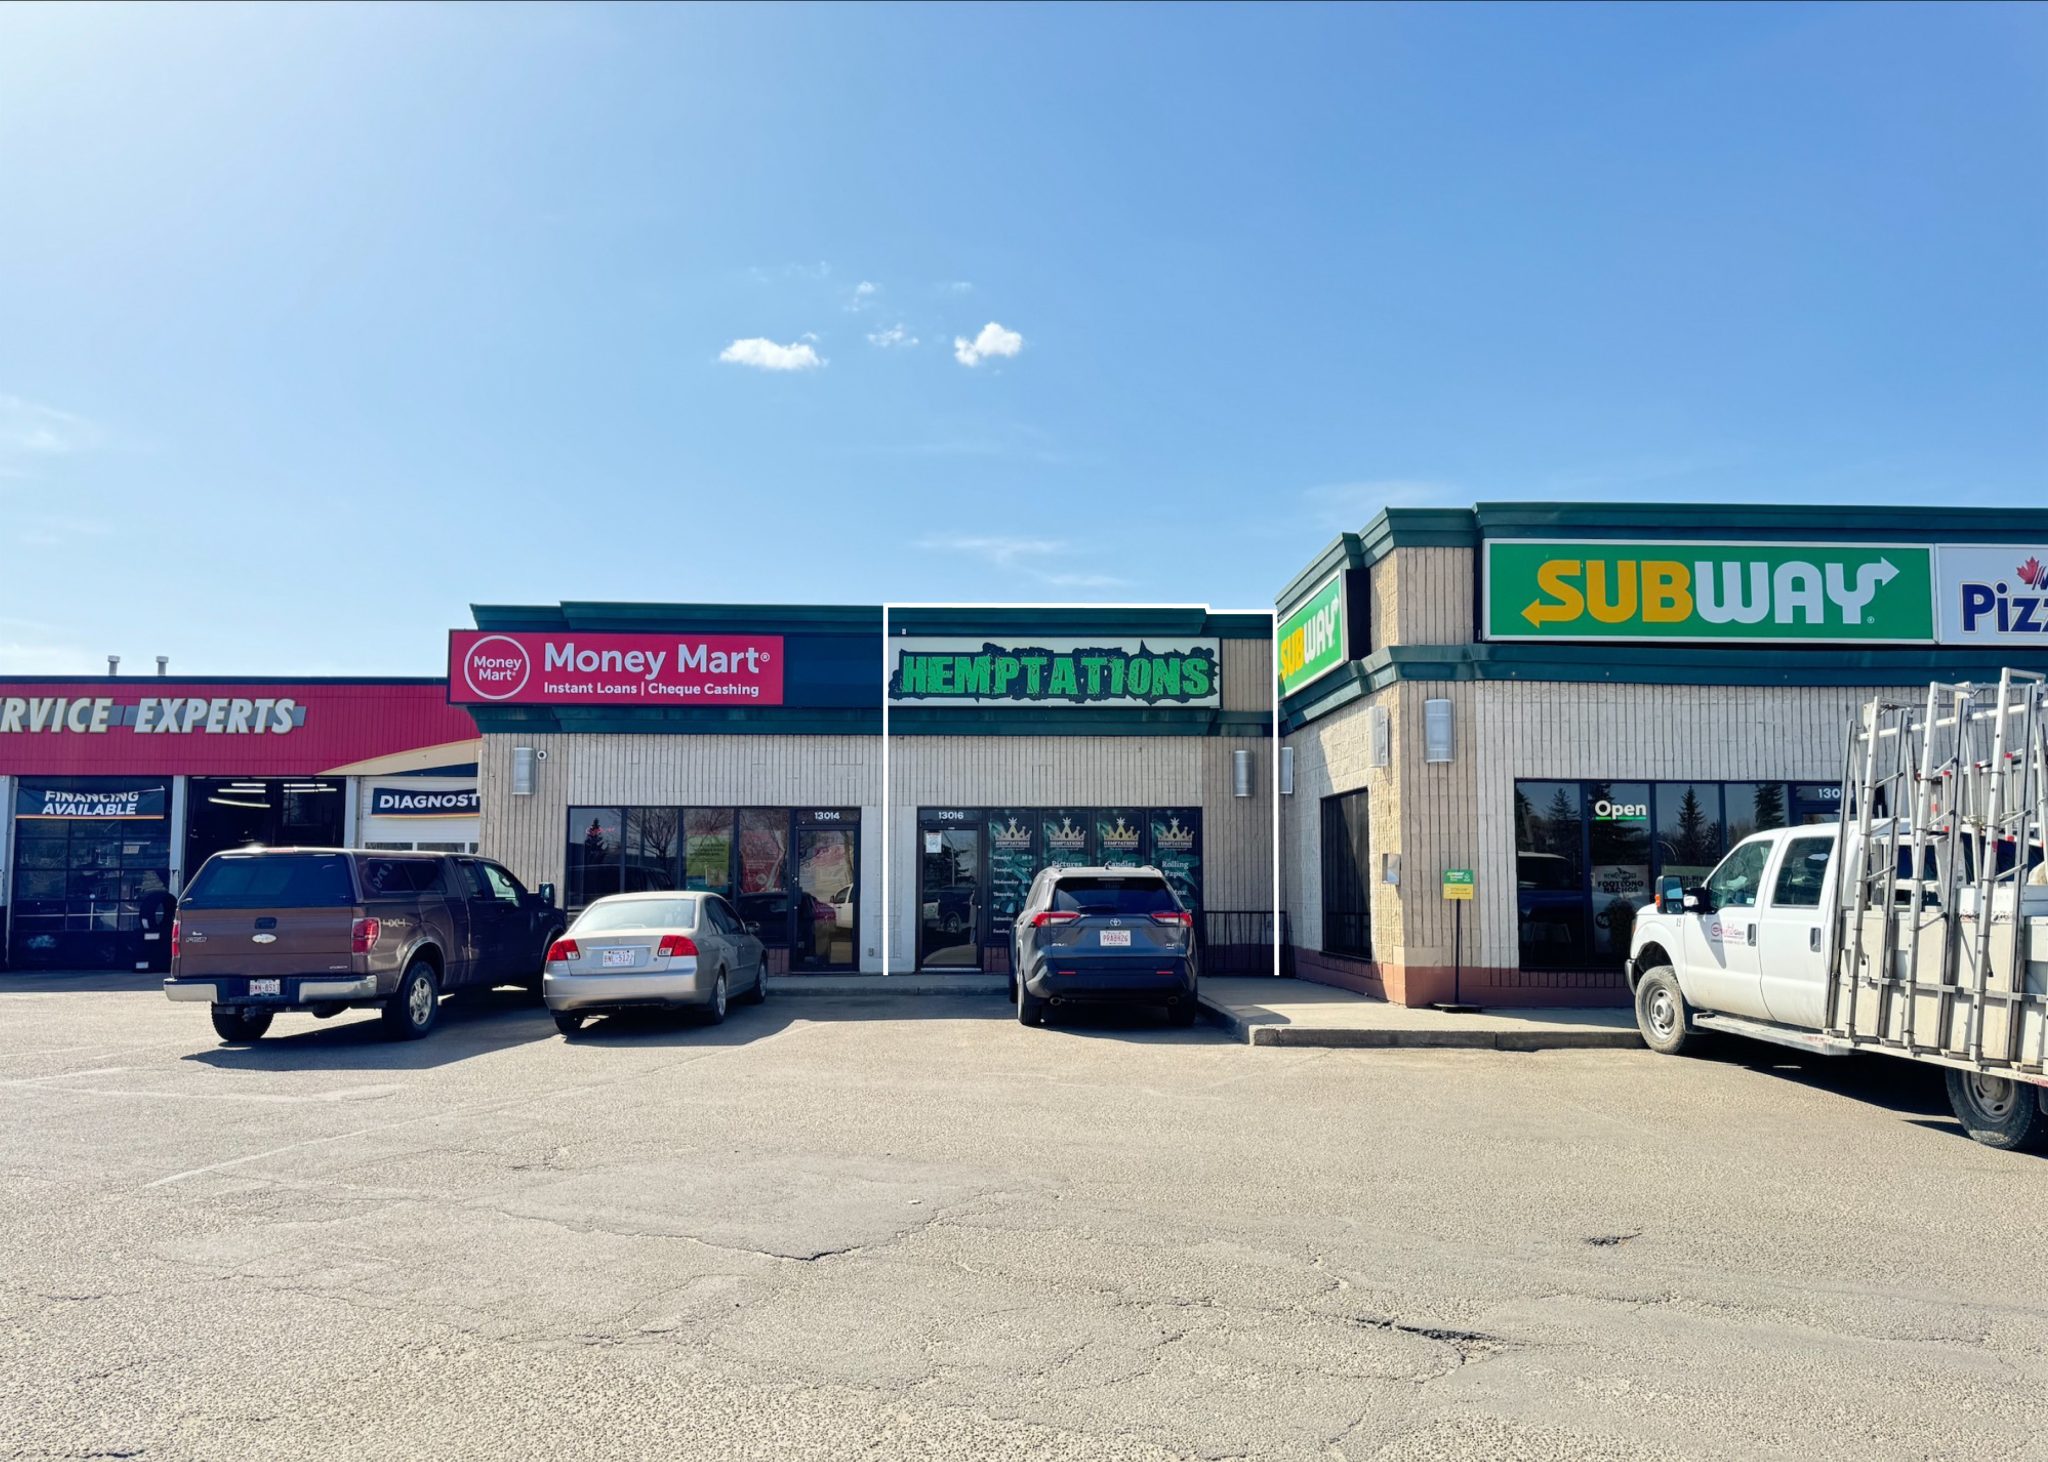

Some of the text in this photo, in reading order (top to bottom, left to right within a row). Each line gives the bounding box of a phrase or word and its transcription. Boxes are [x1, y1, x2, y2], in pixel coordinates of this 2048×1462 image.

[1521, 557, 1900, 629] SUBWAY
[1961, 582, 2048, 632] Piz
[1280, 594, 1339, 682] SUBWAY
[473, 655, 522, 671] Money
[544, 642, 667, 680] Money
[902, 654, 1210, 696] HEMPTATIONS
[544, 682, 593, 694] Instant
[597, 682, 637, 694] Loans
[648, 683, 700, 697] Cheque
[703, 683, 760, 697] Cashing
[0, 697, 296, 734] RVICE EXPERTS
[44, 790, 139, 803] FINANCING
[379, 793, 480, 809] DIAGNOST
[1818, 787, 1853, 799] 130
[42, 803, 137, 816] AVAILABLE
[814, 811, 840, 820] 13014
[938, 811, 964, 820] 13016
[1595, 800, 1647, 820] Open
[1162, 861, 1189, 869] Rolling
[1164, 870, 1187, 879] Paper
